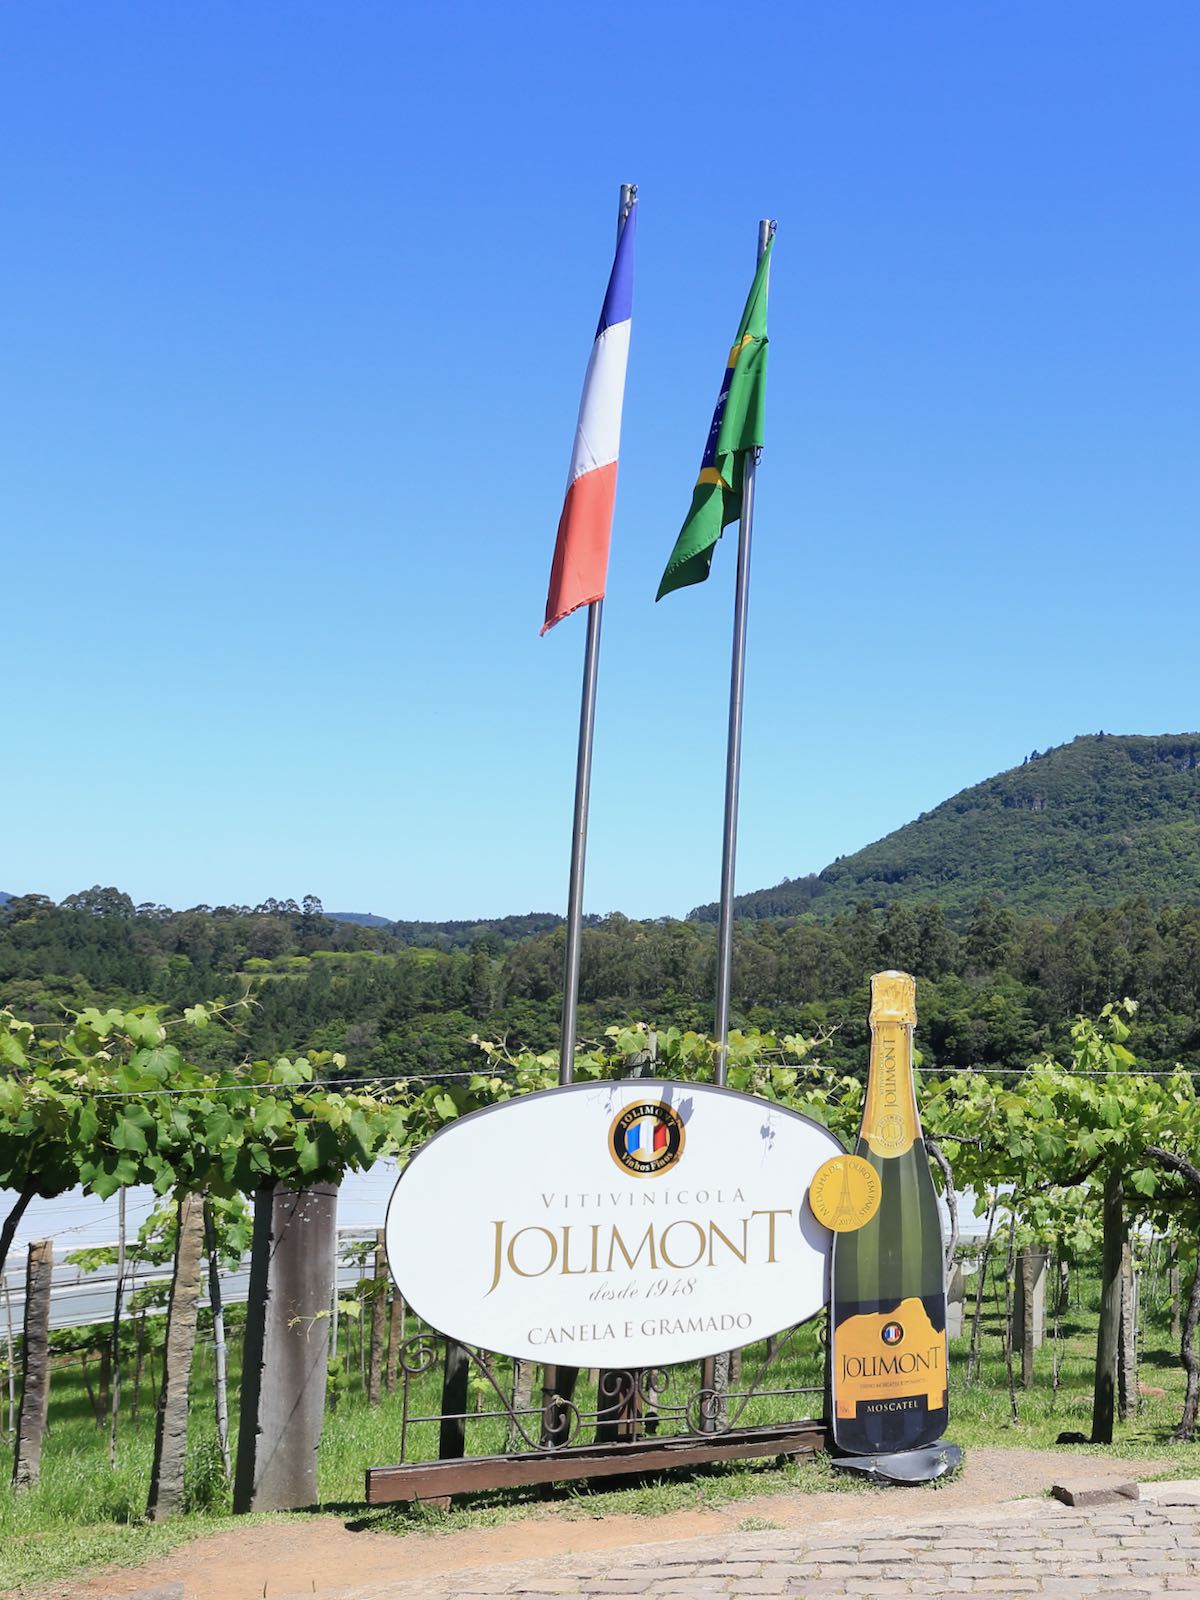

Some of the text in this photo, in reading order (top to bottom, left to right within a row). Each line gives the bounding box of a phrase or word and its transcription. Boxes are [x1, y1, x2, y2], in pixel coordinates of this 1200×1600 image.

[883, 1037, 898, 1108] JOLIMONT
[620, 1105, 676, 1129] JOLIMONT
[622, 1152, 674, 1172] Vinhos Finos
[541, 1188, 746, 1209] VITIVINÍCOLA
[816, 1160, 876, 1217] MEDALHA DE OURO EM PARIS
[482, 1209, 793, 1299] JOLIMONT
[588, 1277, 698, 1302] desde 1948
[527, 1312, 752, 1346] CANELA E GRAMADO
[842, 1347, 940, 1384] JOLIMONT
[866, 1400, 919, 1413] MOSCATEL
